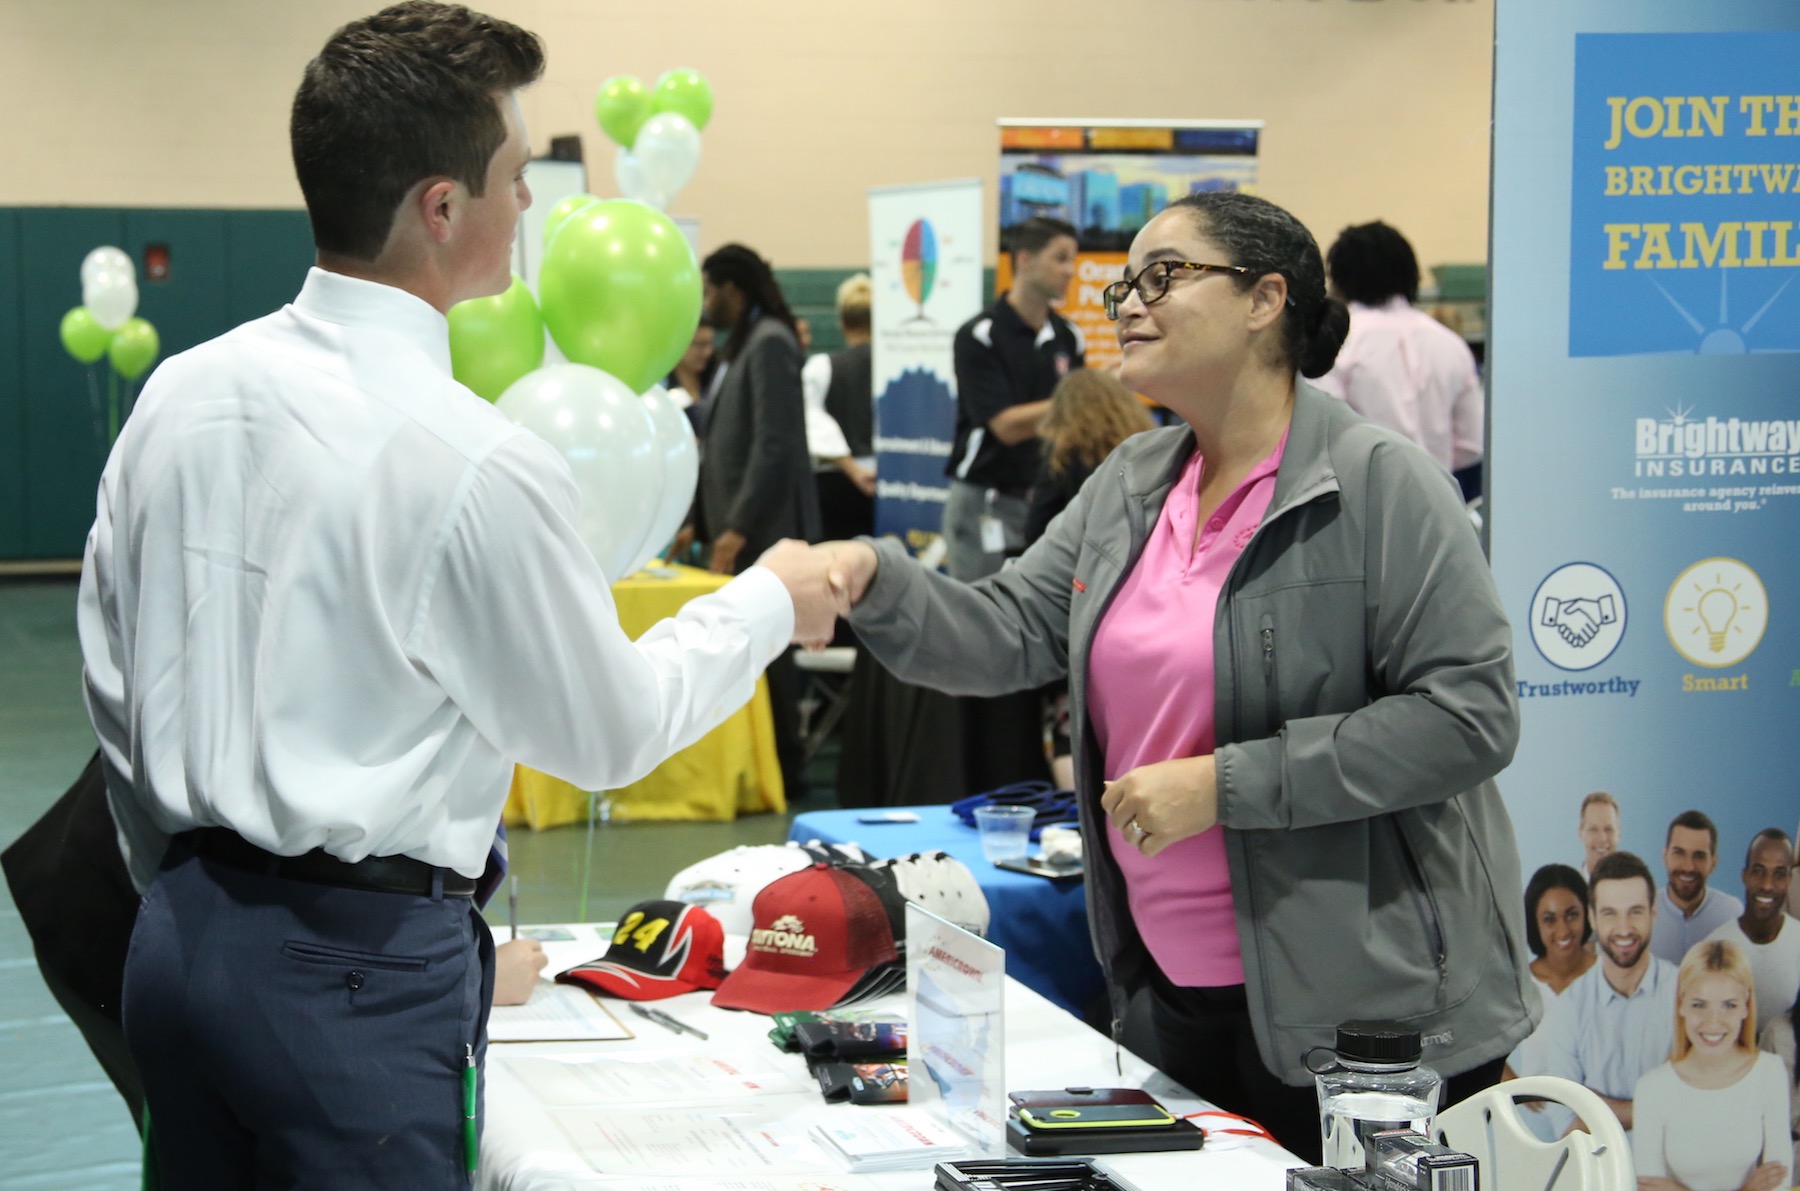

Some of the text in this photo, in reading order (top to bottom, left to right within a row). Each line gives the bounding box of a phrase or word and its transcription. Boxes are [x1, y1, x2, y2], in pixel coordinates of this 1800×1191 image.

[1604, 95, 1800, 150] JOIN TH
[1603, 221, 1800, 270] FAMIL
[1635, 415, 1800, 458] Brightway
[1635, 456, 1800, 477] INSURANCE
[1611, 487, 1636, 500] The
[1638, 486, 1706, 499] insurance
[1708, 485, 1756, 500] agency
[1683, 500, 1731, 512] around
[1516, 673, 1748, 698] Trustworthy Smart
[613, 911, 670, 953] 24
[1421, 1029, 1454, 1048] rmot
